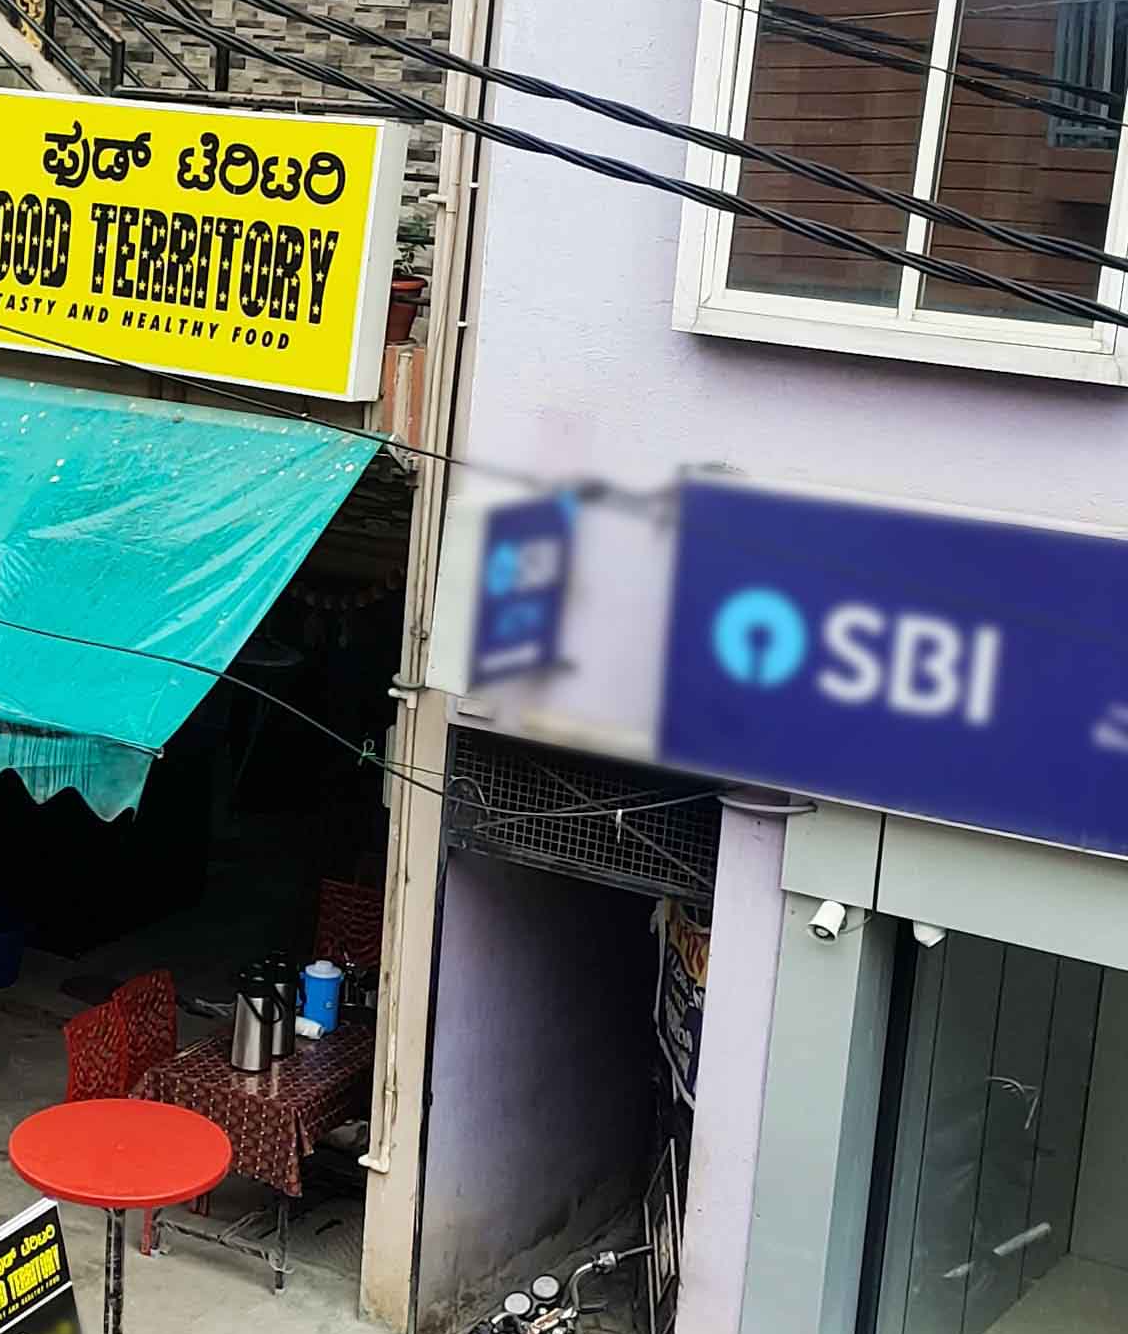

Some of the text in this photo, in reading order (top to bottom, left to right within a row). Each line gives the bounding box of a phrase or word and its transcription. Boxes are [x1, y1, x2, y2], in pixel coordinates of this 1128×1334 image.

[176, 131, 346, 205] ಟೆರಿಟರಿ
[89, 201, 340, 325] TERRITORY
[67, 303, 109, 324] AND
[121, 310, 221, 340] HEALTHY
[231, 326, 291, 351] FOOD
[815, 602, 1003, 727] SBI
[7, 1243, 61, 1300] TERRITORY
